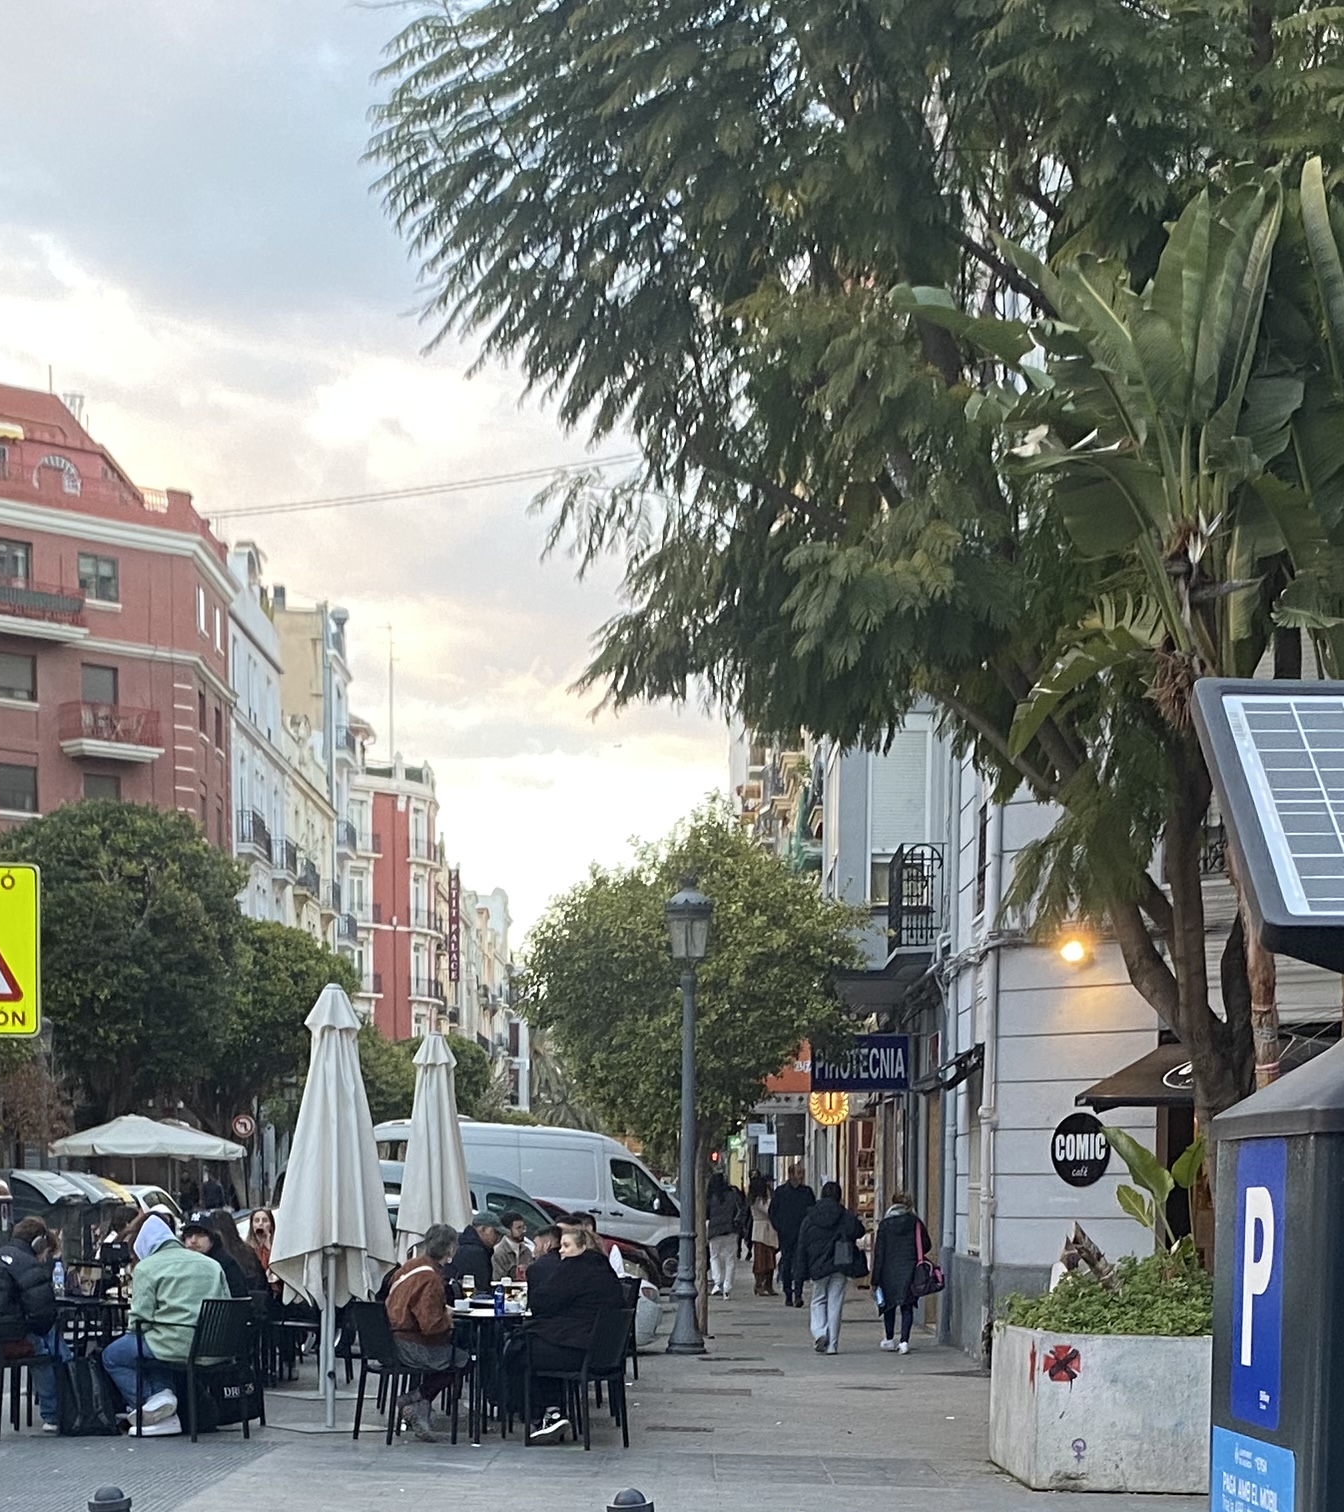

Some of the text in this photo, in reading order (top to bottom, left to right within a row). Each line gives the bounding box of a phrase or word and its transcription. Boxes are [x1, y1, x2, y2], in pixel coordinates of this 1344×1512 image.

[450, 923, 458, 980] PALACE
[1055, 1132, 1107, 1162] COMIC
[1241, 1186, 1275, 1367] P
